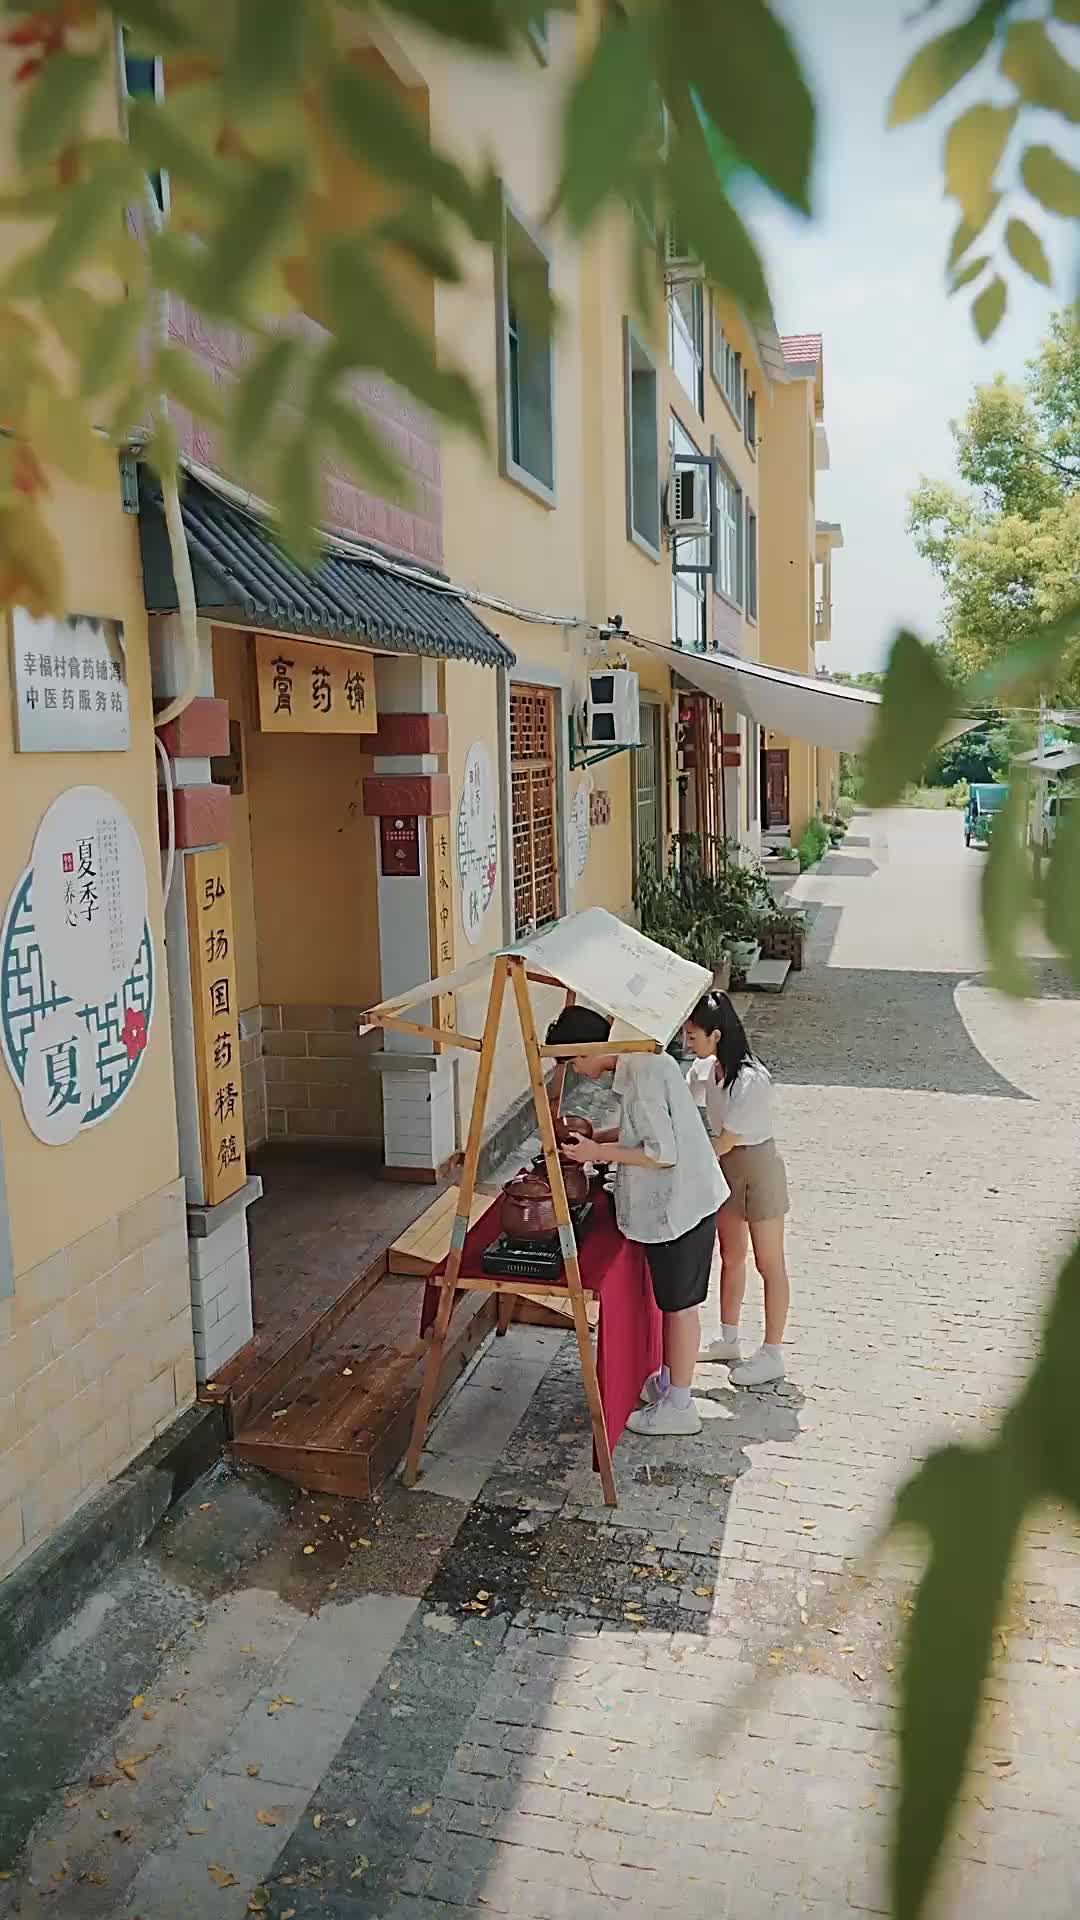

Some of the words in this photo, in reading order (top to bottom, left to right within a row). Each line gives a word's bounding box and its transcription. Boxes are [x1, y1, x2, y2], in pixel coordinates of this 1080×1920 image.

[26, 686, 122, 713] 中医药服务站
[270, 655, 366, 717] 膏药铺
[76, 836, 99, 922] 夏季
[203, 876, 241, 1176] 弘扬国药精髓
[40, 1035, 81, 1117] 夏
